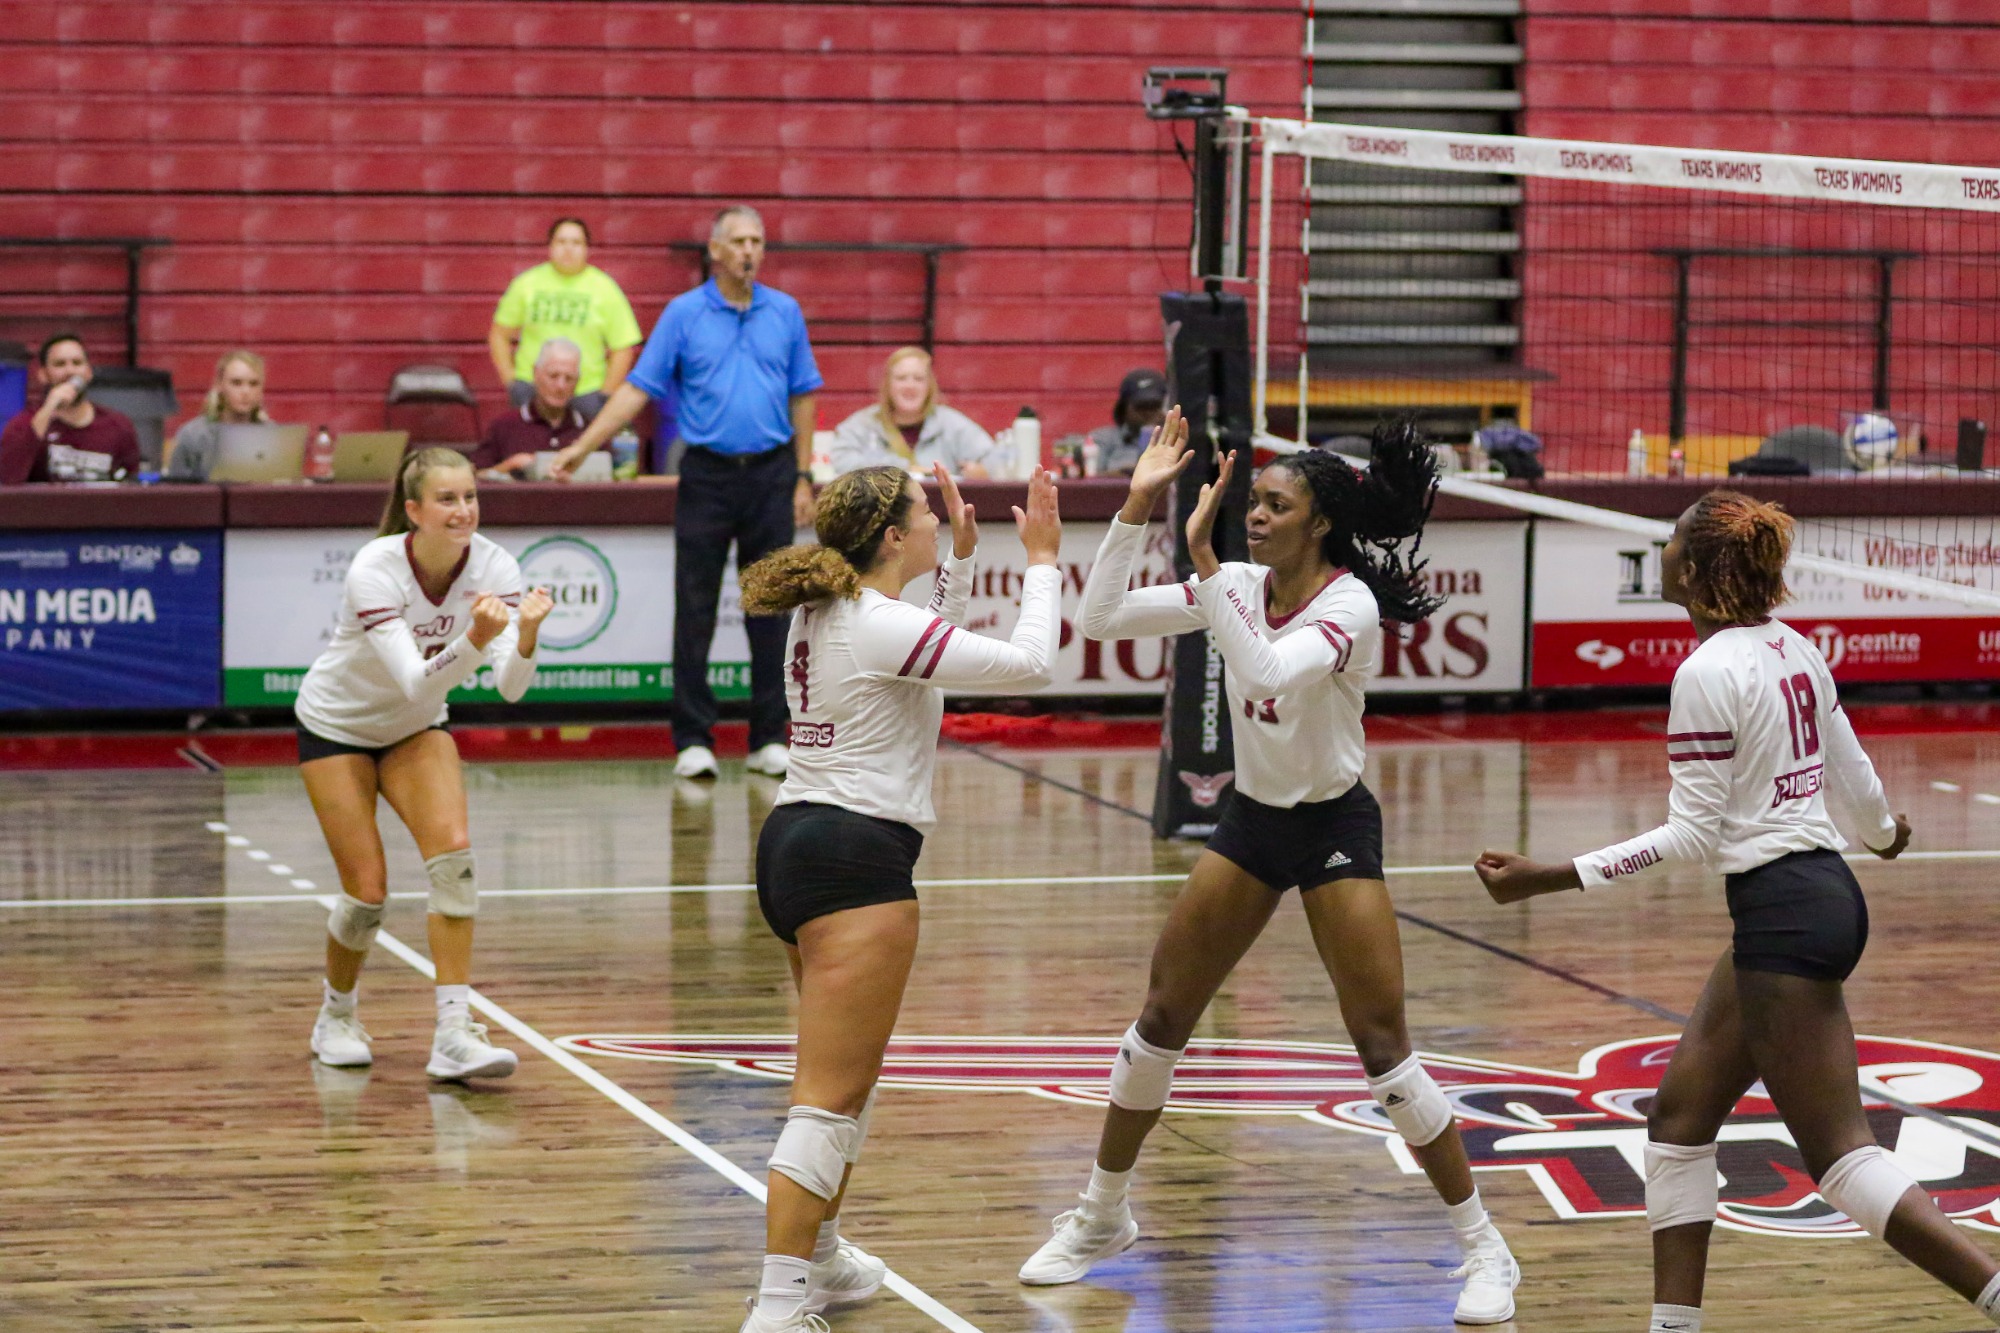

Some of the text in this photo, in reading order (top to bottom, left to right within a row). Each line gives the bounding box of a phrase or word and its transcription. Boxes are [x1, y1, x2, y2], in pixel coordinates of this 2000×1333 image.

[1560, 150, 1589, 169] TEXAS
[1681, 158, 1714, 178] TEXAS
[1814, 166, 1849, 190] TEXAS
[1961, 176, 2000, 200] TEXAS
[79, 545, 162, 564] DENTON
[1863, 537, 1938, 567] Where
[36, 588, 156, 623] MEDIA
[1847, 630, 1921, 653] centre
[1200, 679, 1220, 754] imports
[1779, 671, 1820, 761] 18
